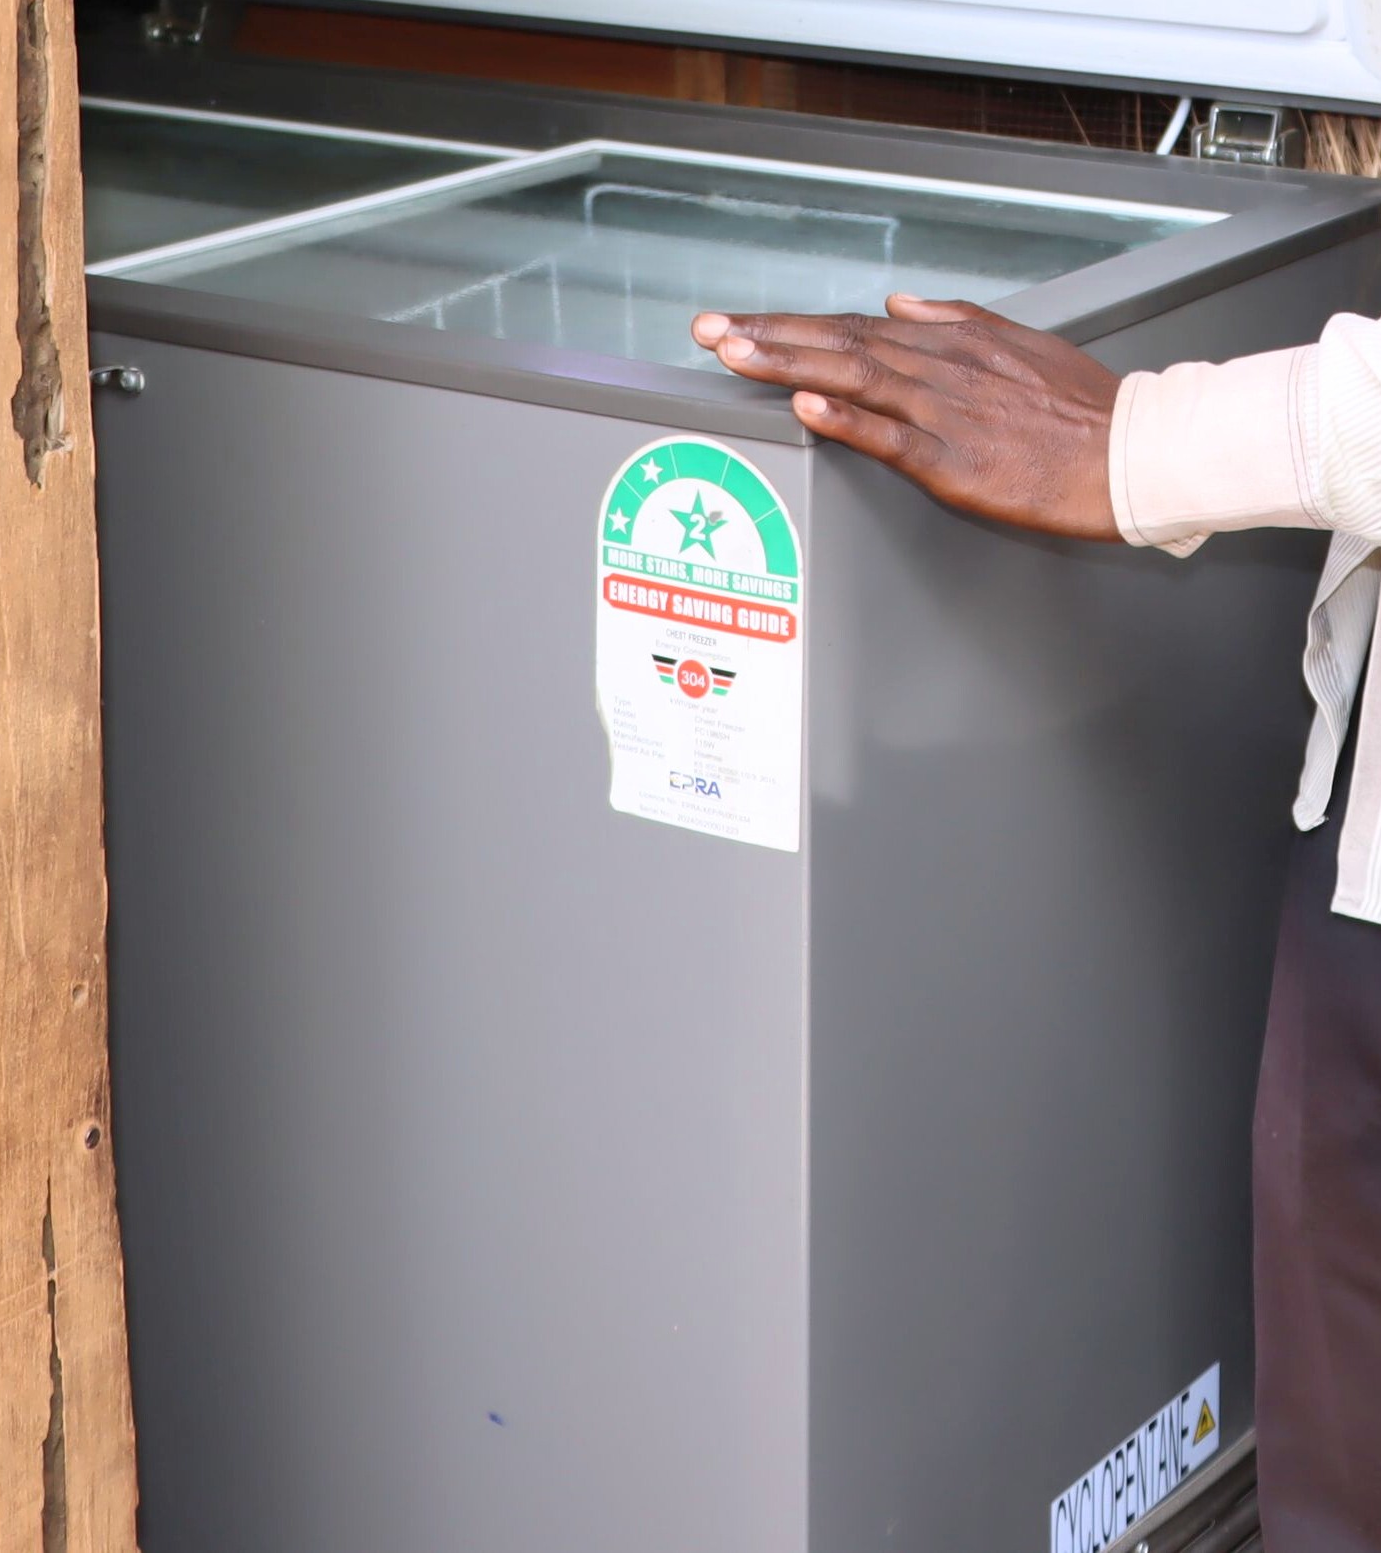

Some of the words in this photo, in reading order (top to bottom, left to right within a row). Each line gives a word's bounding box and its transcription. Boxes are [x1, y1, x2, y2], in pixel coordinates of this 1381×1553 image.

[689, 514, 707, 542] 2
[609, 549, 643, 569] MORE
[646, 554, 690, 582] STARS,
[692, 565, 729, 590] MORE
[732, 574, 792, 602] SAVINGS
[609, 580, 669, 611] ENERGY
[673, 595, 733, 626] SAVING
[737, 608, 790, 636] GUIDE
[666, 628, 687, 641] CHEST
[688, 633, 718, 647] FREEZER
[681, 671, 706, 688] 304
[669, 770, 722, 800] EPRA
[1055, 1391, 1190, 1553] CYCLOPENTANE
